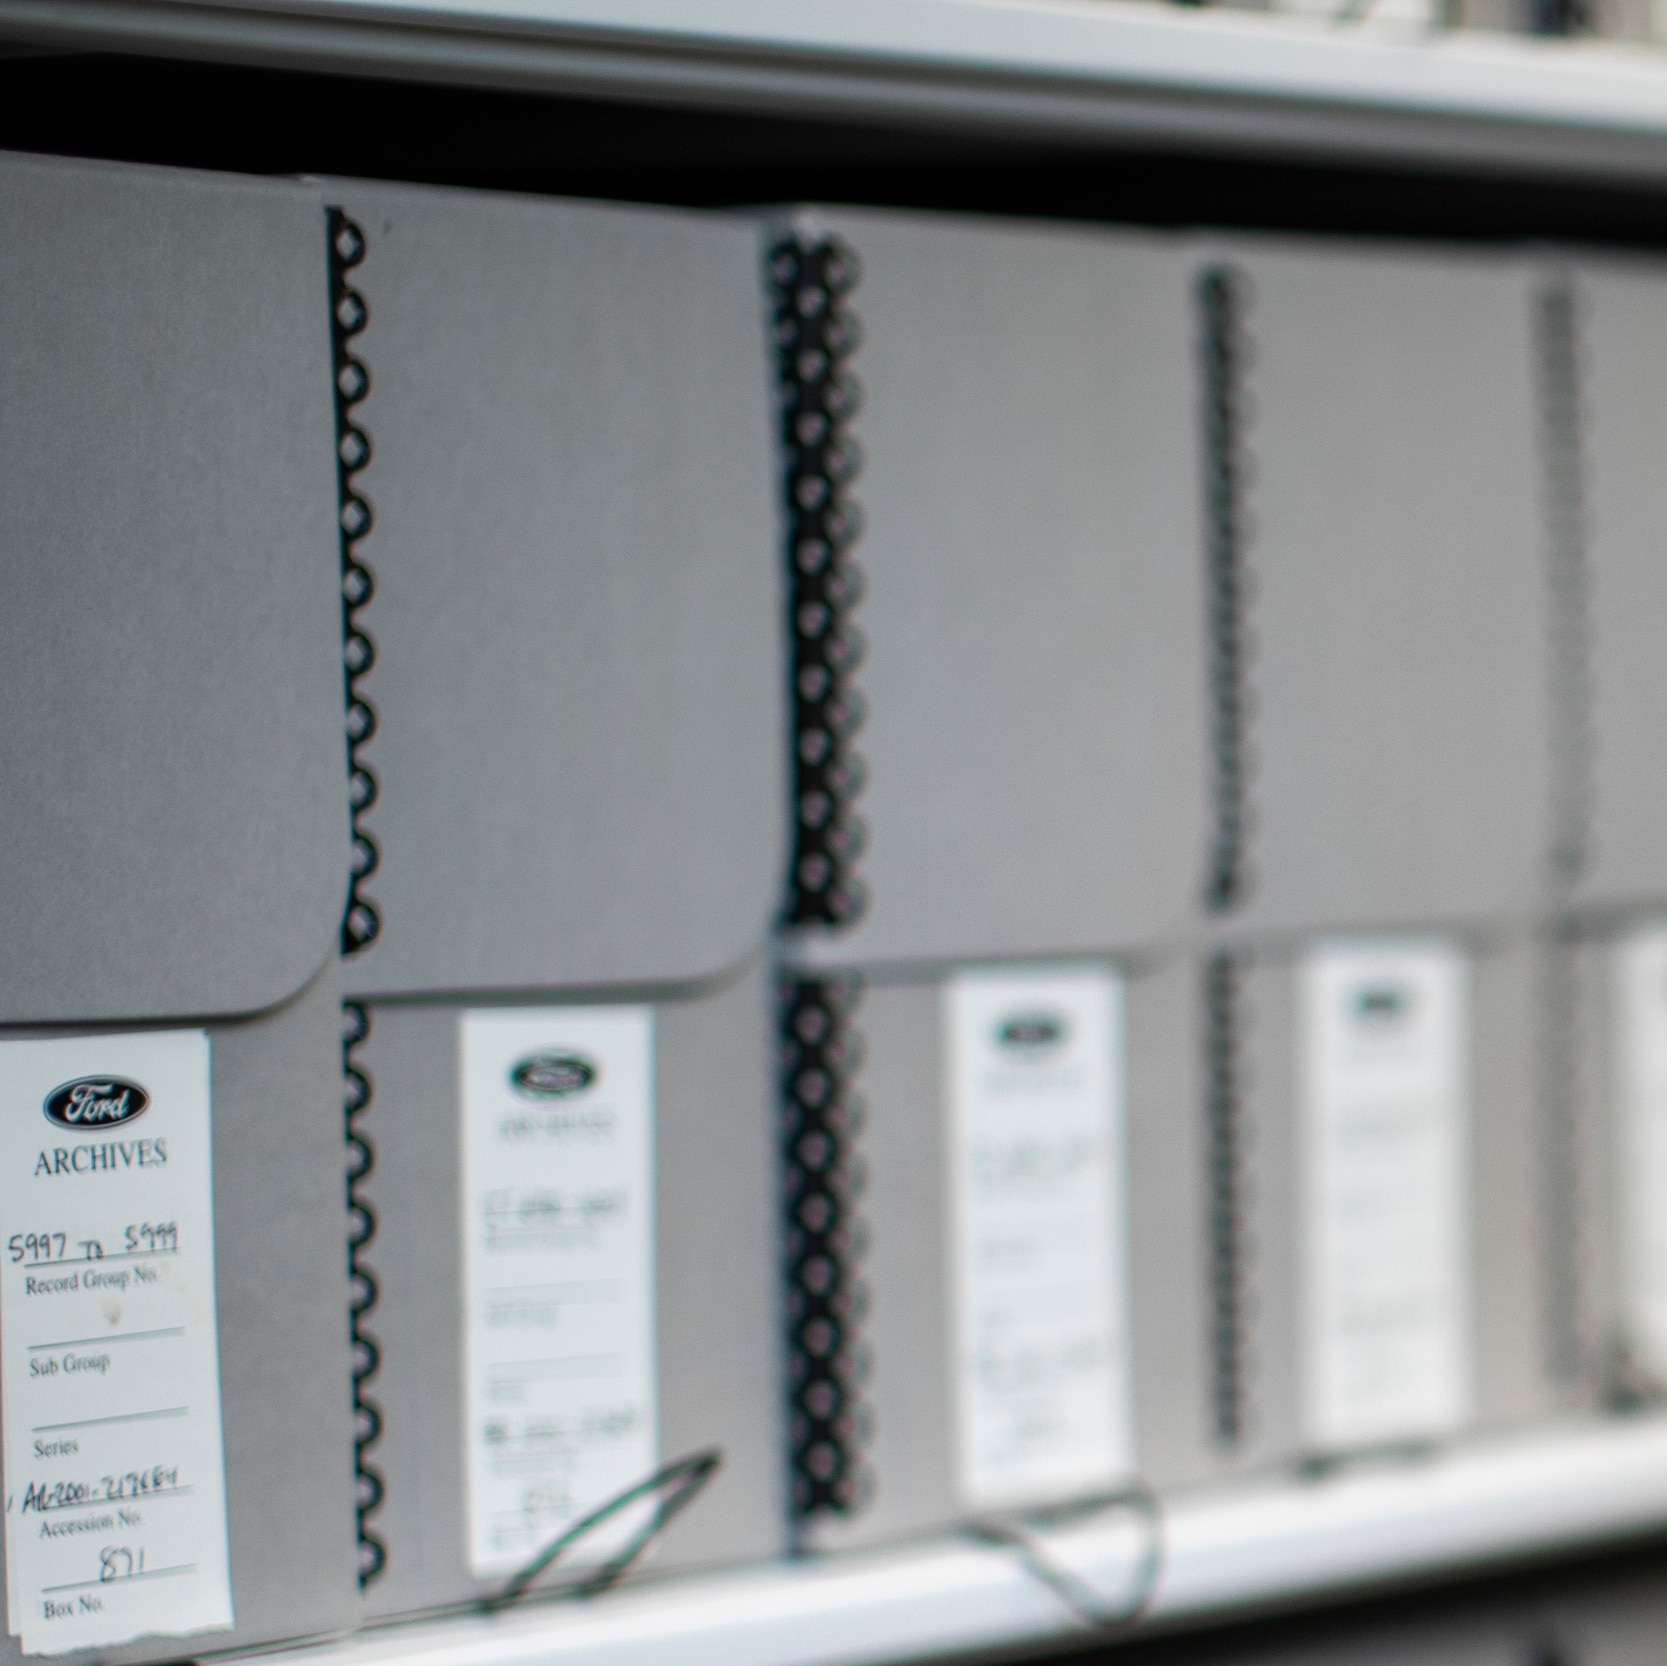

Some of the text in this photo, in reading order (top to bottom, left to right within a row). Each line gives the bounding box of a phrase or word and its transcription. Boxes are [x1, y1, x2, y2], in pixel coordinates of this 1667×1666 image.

[33, 1136, 169, 1177] ARCHIVES
[8, 1232, 67, 1262] 5997
[124, 1220, 179, 1253] 5999
[25, 1272, 79, 1296] Record
[83, 1268, 131, 1292] Group
[29, 1352, 111, 1378] Sub Group
[33, 1438, 79, 1460] Series
[40, 1513, 115, 1539] Accession
[99, 1545, 145, 1583] 871
[44, 1599, 74, 1620] Box
